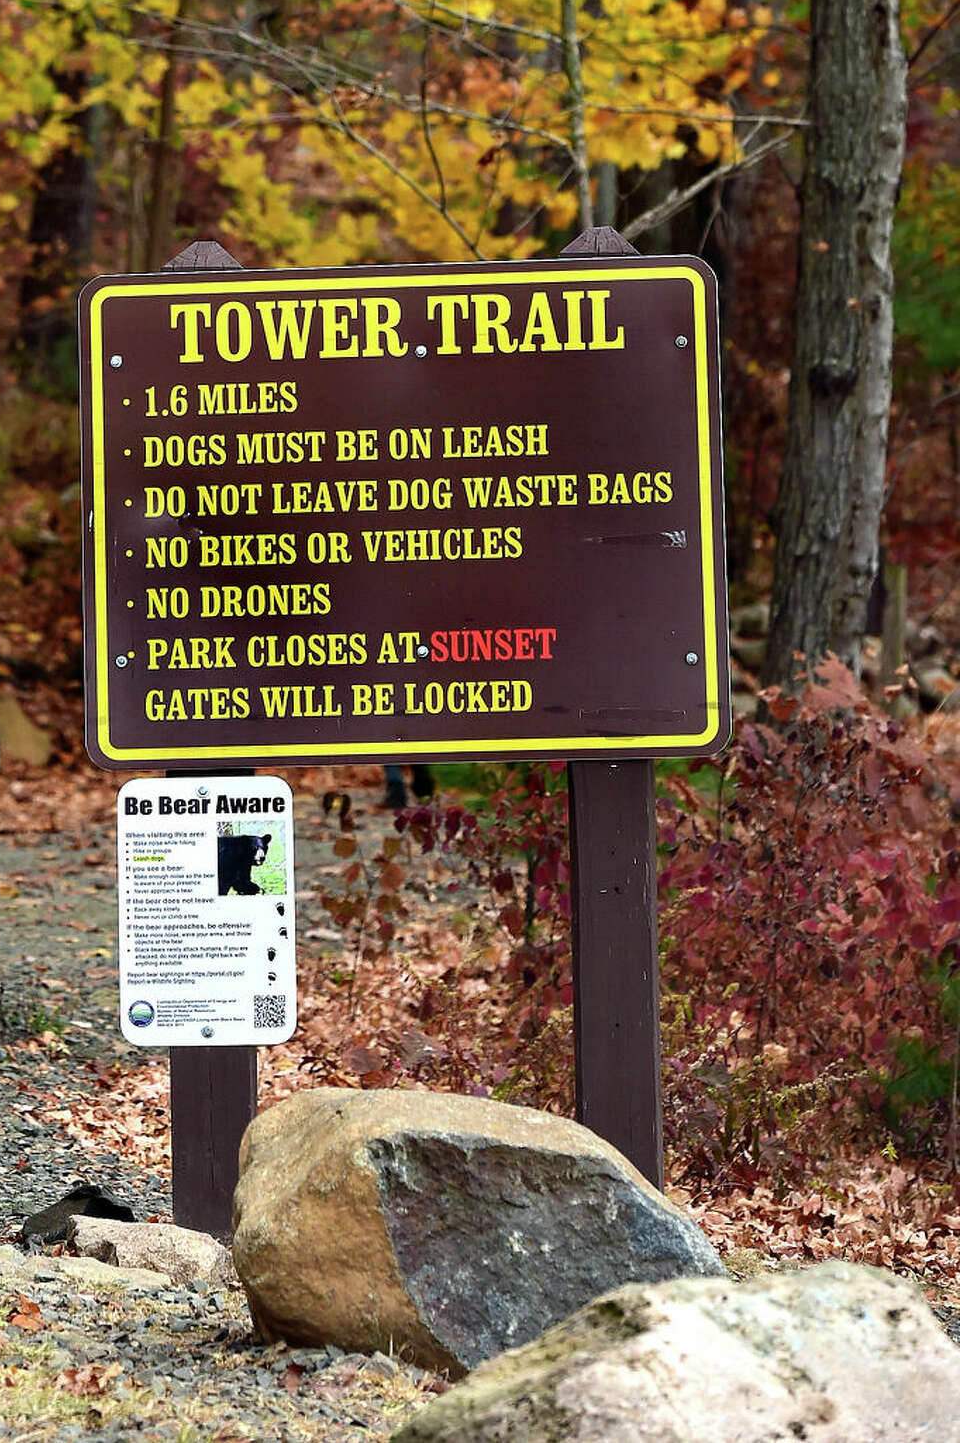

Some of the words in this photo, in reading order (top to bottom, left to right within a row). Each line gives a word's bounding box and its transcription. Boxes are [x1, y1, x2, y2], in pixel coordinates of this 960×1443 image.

[169, 296, 409, 363] TOWER
[427, 289, 625, 355] TRAIL
[145, 384, 188, 417] 1.6
[197, 381, 298, 415] MILES
[143, 434, 227, 467] DOGS
[236, 431, 326, 464] MUST
[335, 429, 379, 462] BE
[389, 428, 433, 460] ON
[442, 424, 549, 458] LEASH
[143, 485, 186, 518] DO
[196, 483, 262, 517] NOT
[271, 480, 378, 514] LEAVE
[388, 477, 453, 511] DOG
[462, 474, 578, 509] WASTE
[587, 471, 673, 505] BAGS
[145, 536, 188, 569] NO
[199, 533, 297, 567] BIKES
[307, 532, 352, 564] OR
[361, 526, 523, 562] VEHICLES
[146, 587, 189, 619] NO
[200, 583, 332, 618] DRONES
[147, 636, 236, 670] PARK
[247, 633, 368, 668] CLOSES
[377, 631, 420, 664] AT
[430, 628, 557, 663] SUNSET
[145, 687, 251, 721] GATES
[259, 685, 342, 718] WILL
[351, 683, 395, 716] BE
[404, 680, 533, 714] LOCKED
[124, 797, 153, 816] Be
[158, 796, 211, 815] Bear
[216, 794, 285, 815] Aware
